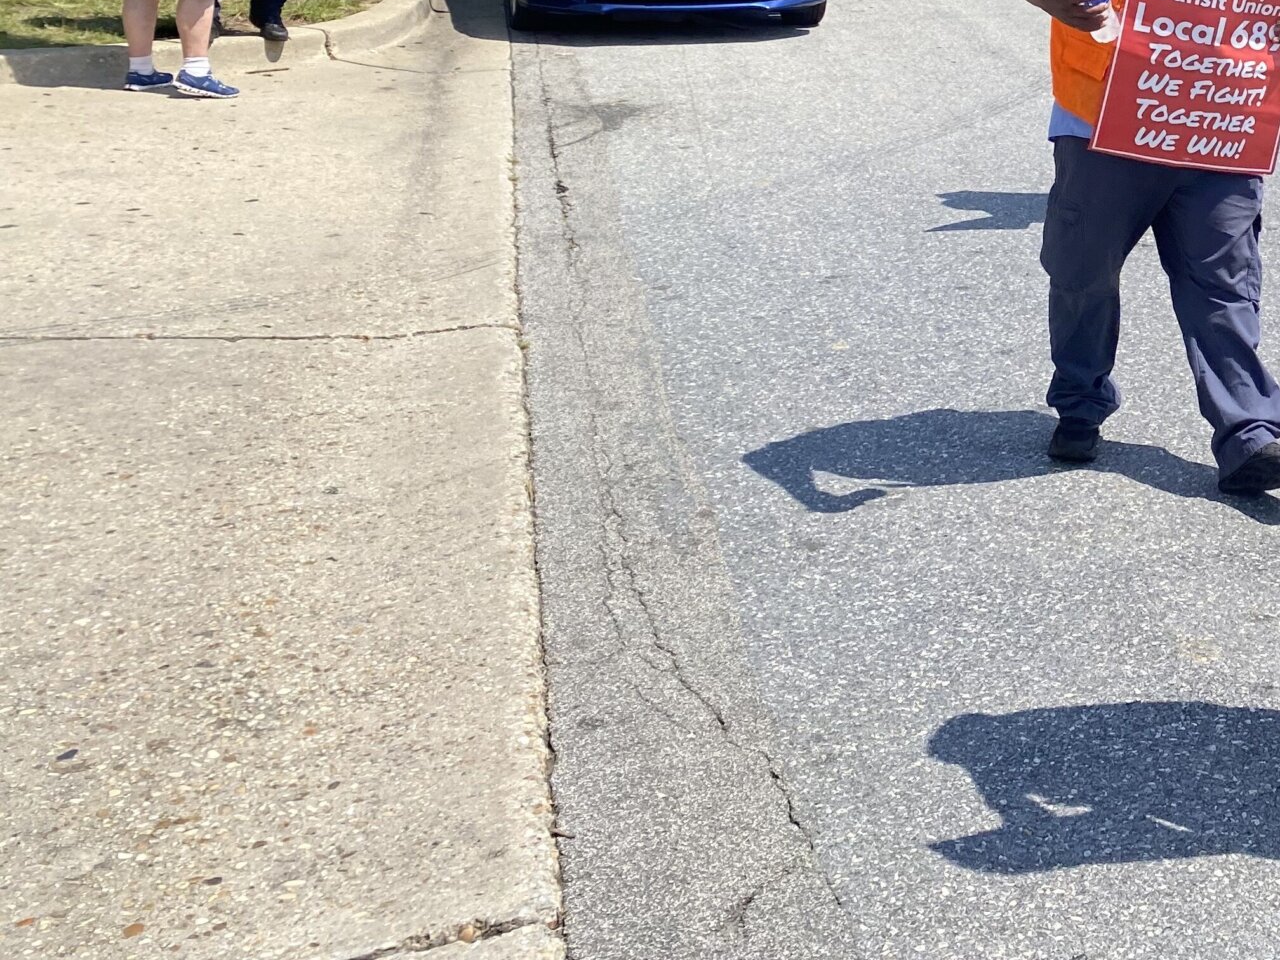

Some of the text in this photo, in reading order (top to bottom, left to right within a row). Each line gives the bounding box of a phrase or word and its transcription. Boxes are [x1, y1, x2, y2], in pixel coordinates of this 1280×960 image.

[1133, 2, 1227, 46] Local
[1149, 43, 1267, 79] TOGETHER
[1138, 70, 1266, 107] WE FIGHT!
[1136, 98, 1255, 134] TOGETHER
[1135, 127, 1246, 159] WE WIN!
